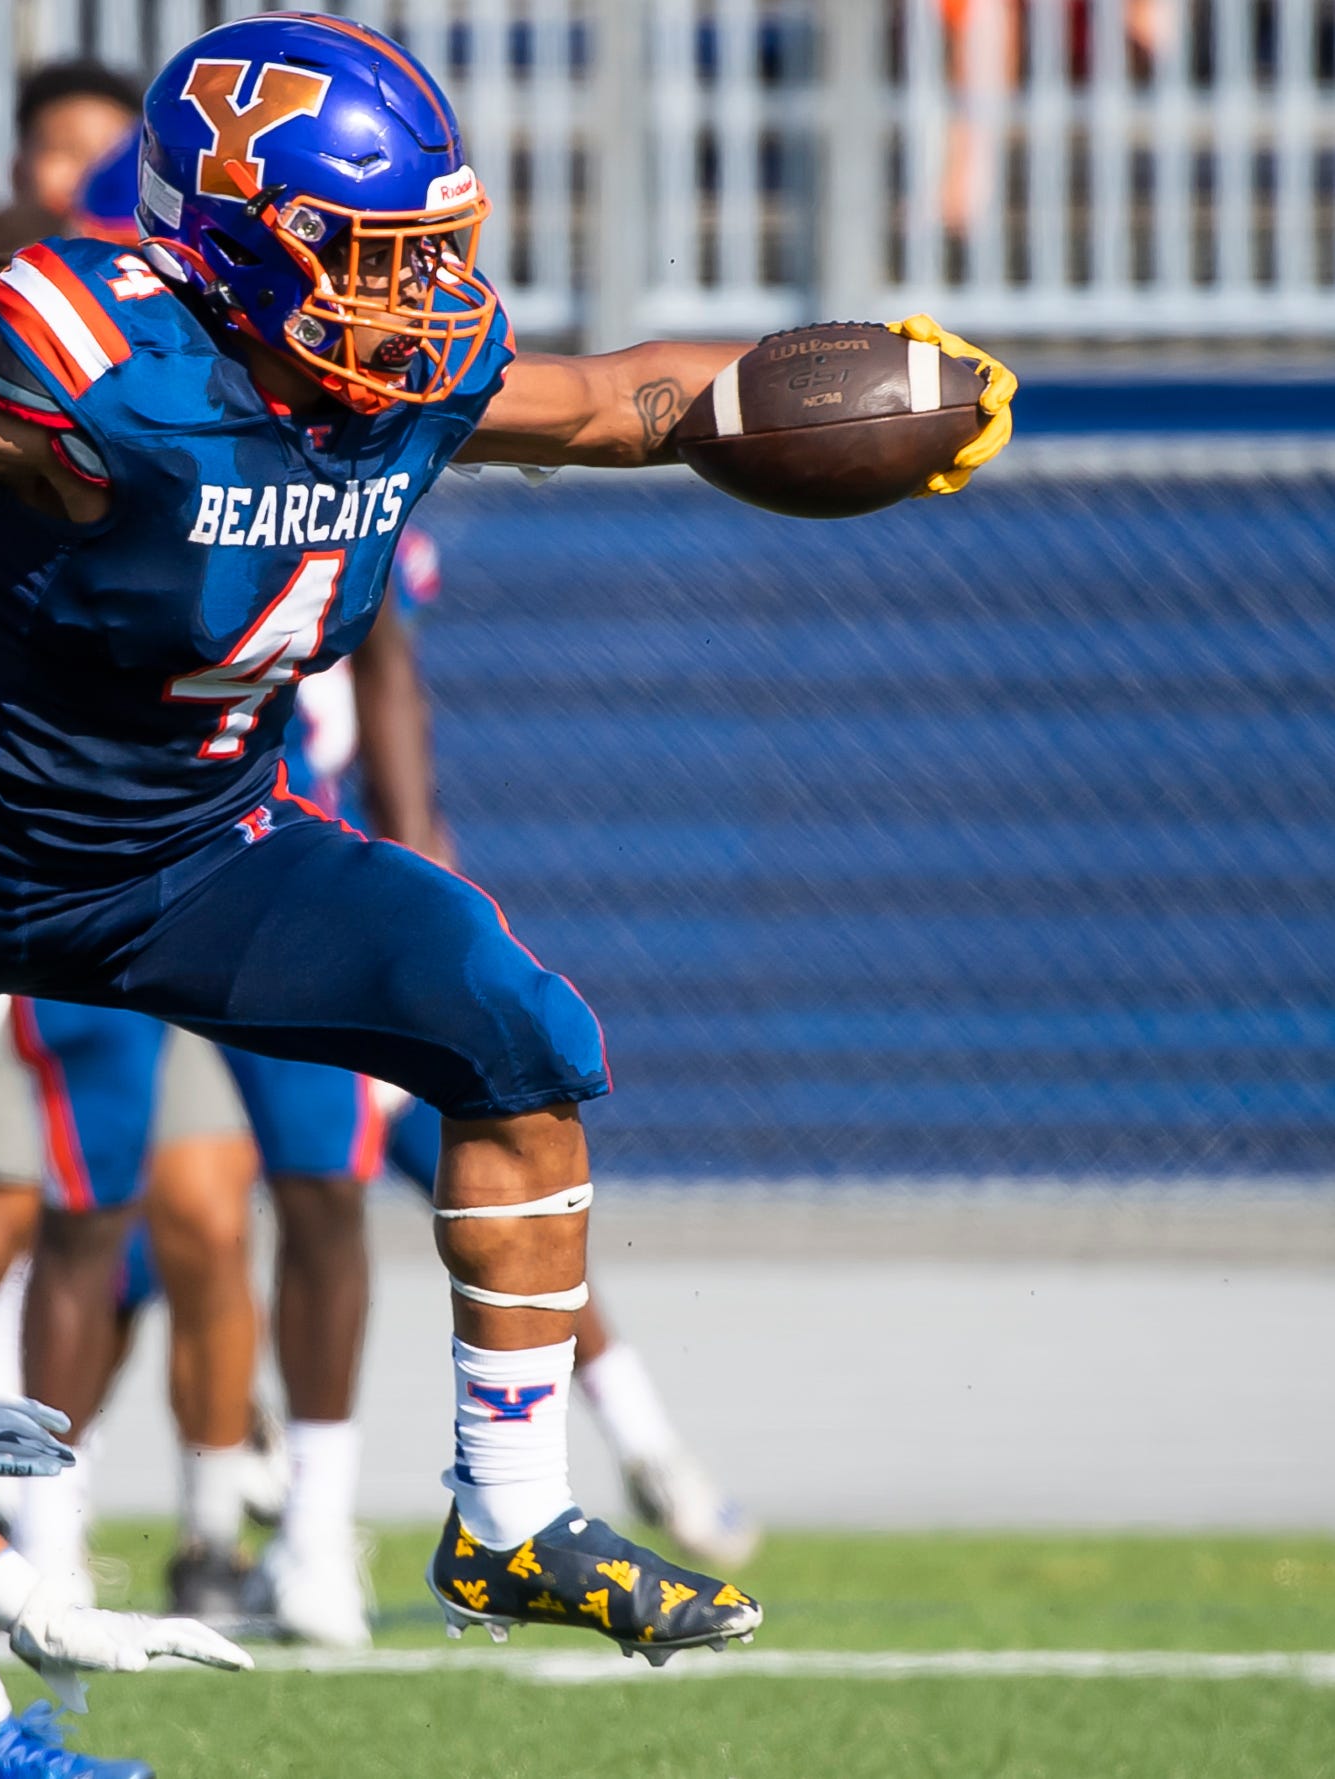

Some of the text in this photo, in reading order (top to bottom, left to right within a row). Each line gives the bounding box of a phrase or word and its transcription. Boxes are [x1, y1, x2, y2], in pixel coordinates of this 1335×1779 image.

[180, 58, 333, 204] Y
[107, 253, 174, 302] 4
[769, 338, 870, 361] Wilson
[187, 472, 410, 547] BEARCATS
[161, 549, 346, 760] 4
[467, 1381, 557, 1423] Y
